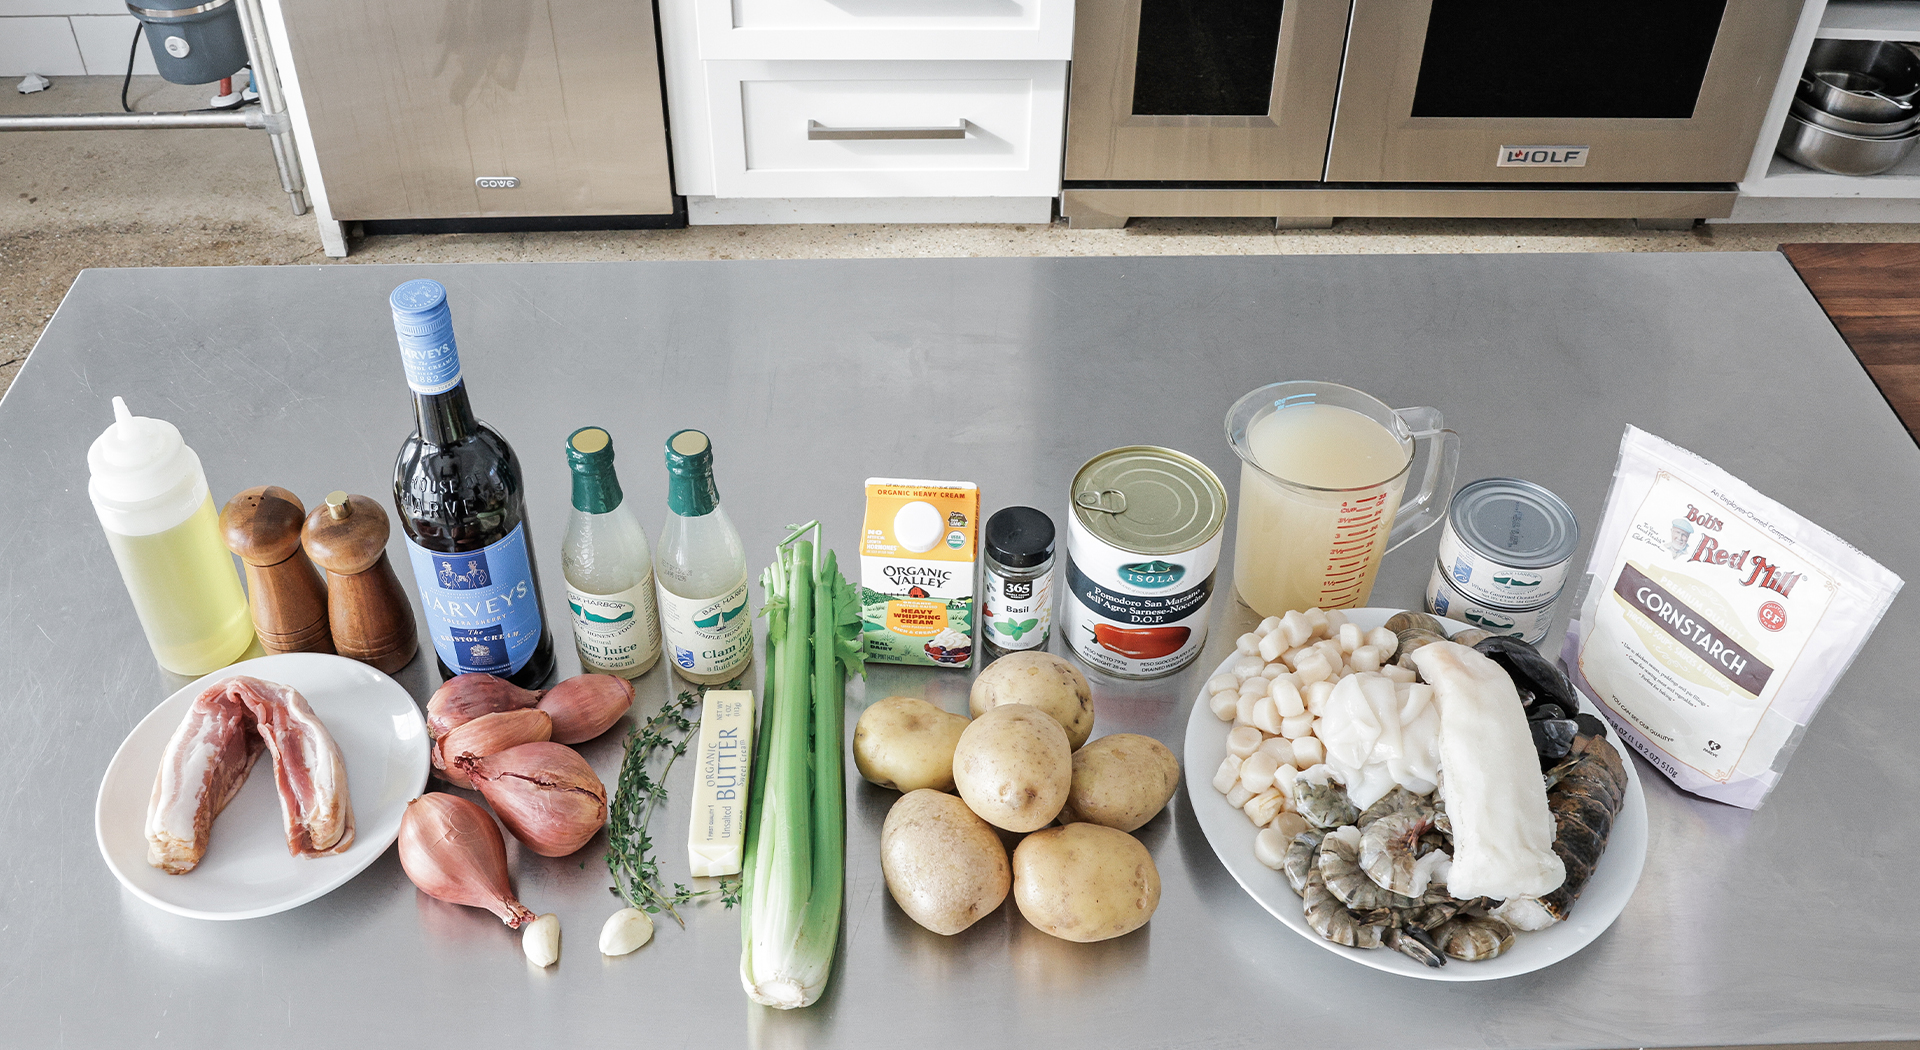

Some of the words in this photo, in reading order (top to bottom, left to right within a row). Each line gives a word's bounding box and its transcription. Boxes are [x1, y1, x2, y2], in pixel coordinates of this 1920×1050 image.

[1507, 150, 1581, 163] WOLF
[480, 180, 515, 188] COVE
[414, 374, 440, 383] 1882
[877, 489, 911, 497] ORGANIC
[913, 490, 937, 498] HEAVY
[1684, 503, 1724, 533] Bob's
[1711, 489, 1720, 497] An
[1720, 494, 1769, 528] Employee-Owned
[1768, 524, 1796, 546] Company
[883, 565, 952, 580] ORGANIC
[1687, 533, 1750, 571] Red
[1738, 555, 1802, 599] Mill
[889, 575, 946, 588] VALLEY
[1128, 574, 1175, 583] ISOLA
[1005, 583, 1030, 593] 365
[419, 580, 527, 618] HARVEYS
[1094, 586, 1142, 607] Pomodoro
[1165, 589, 1200, 606] Marzano
[583, 599, 624, 610] HARBOR
[702, 604, 720, 616] BAR
[1006, 605, 1029, 613] Basil
[1129, 592, 1205, 615] Sarnese-Nocerino
[1660, 576, 1703, 610] PREMIUM
[1705, 608, 1744, 640] QUALITY
[442, 616, 471, 626] SOLERA
[475, 613, 506, 625] SHERRY
[1131, 615, 1164, 623] D.O.P.
[1762, 608, 1783, 624] GF
[440, 634, 480, 643] BRISTOL
[483, 630, 520, 641] CREAM
[467, 628, 484, 636] The
[893, 626, 908, 634] RICH
[1636, 587, 1747, 676] CORNSTARCH
[574, 631, 600, 653] Clam
[604, 643, 637, 656] Juice
[588, 637, 612, 645] Natural
[702, 644, 736, 660] Clam
[1084, 645, 1096, 654] PESO
[1096, 652, 1114, 662] NETTO
[1626, 609, 1654, 634] THICKENS
[1674, 645, 1697, 668] SAUCES
[1696, 663, 1703, 671] &
[1703, 669, 1731, 691] FILLINGS
[609, 660, 624, 668] 240
[625, 658, 636, 667] ml
[714, 652, 738, 664] READY
[713, 660, 731, 672] fluid
[1141, 664, 1166, 673] DRAINED
[717, 700, 724, 709] WT
[1612, 694, 1622, 707] YOU
[1620, 704, 1632, 717] CAN
[1631, 713, 1640, 723] SEE
[1639, 720, 1650, 731] OUR
[739, 739, 747, 763] Cream
[1611, 719, 1618, 730] 18
[1618, 727, 1628, 738] OZ
[1635, 740, 1644, 751] LB
[1643, 747, 1649, 756] 2
[1649, 752, 1661, 765] OZ)
[1660, 761, 1678, 779] 510g
[1703, 747, 1719, 759] PAREVE
[705, 742, 717, 788] ORGANIC
[716, 726, 738, 800] BUTTER
[737, 765, 747, 787] Sweet
[721, 805, 732, 838] Unsalted
